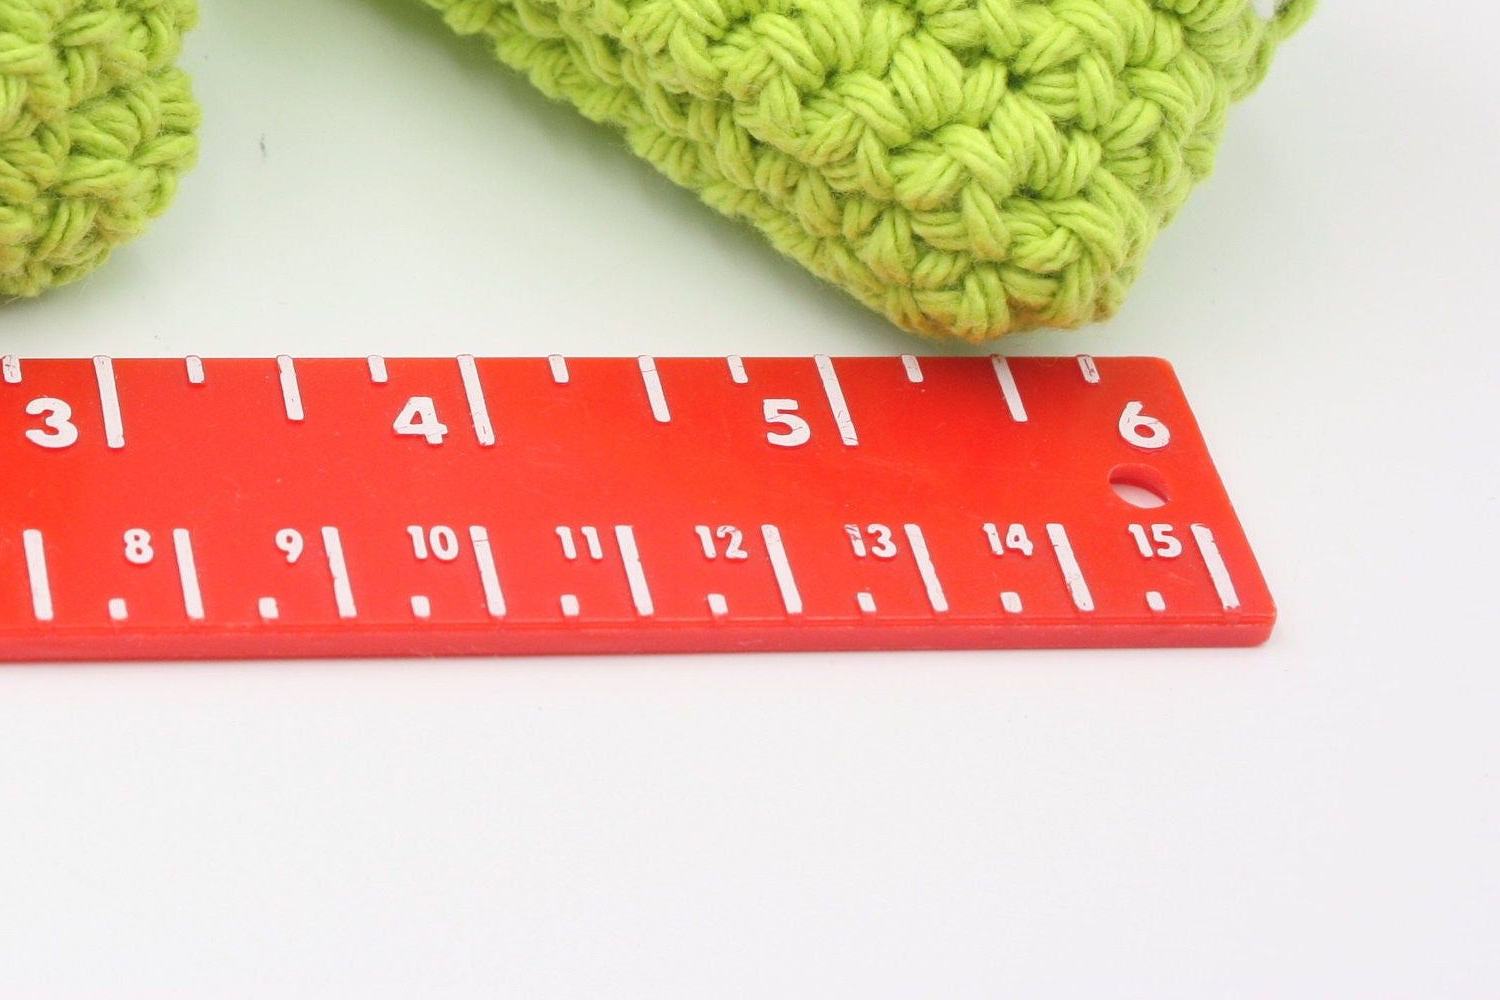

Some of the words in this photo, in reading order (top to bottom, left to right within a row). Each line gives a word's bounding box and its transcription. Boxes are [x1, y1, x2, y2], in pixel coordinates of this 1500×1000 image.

[23, 395, 80, 450] 3
[391, 395, 450, 446] 4
[761, 397, 812, 448] 5
[1117, 399, 1172, 450] 6
[122, 526, 156, 565] 8
[273, 526, 306, 564] 9
[405, 523, 461, 562] 10
[554, 524, 605, 561] 11
[693, 523, 750, 560] 12
[843, 522, 899, 559] 13
[981, 521, 1035, 557] 14
[1126, 522, 1184, 559] 15
